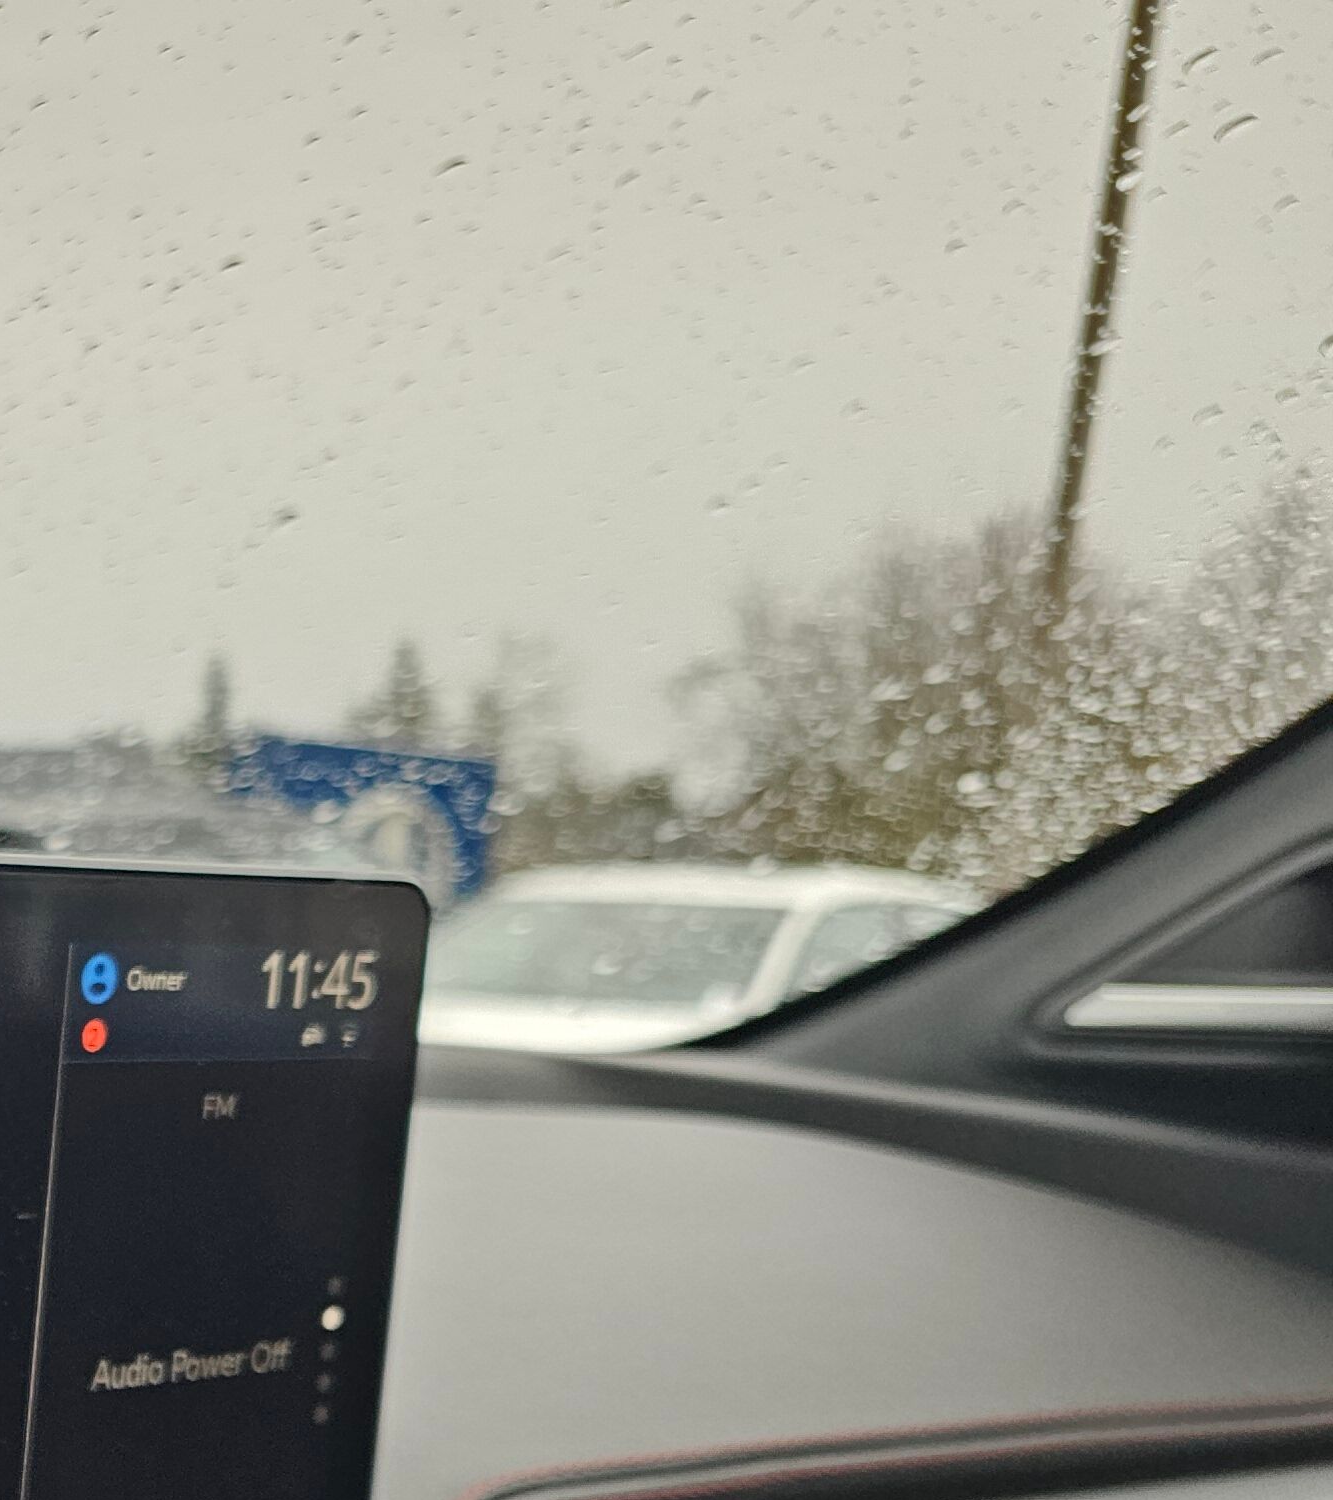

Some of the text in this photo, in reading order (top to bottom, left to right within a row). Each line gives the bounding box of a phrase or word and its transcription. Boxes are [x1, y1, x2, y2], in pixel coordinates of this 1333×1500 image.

[126, 967, 188, 992] Owner
[261, 949, 379, 1010] 11:45
[202, 1093, 238, 1120] FM
[90, 1339, 292, 1391] Audio Power Off
